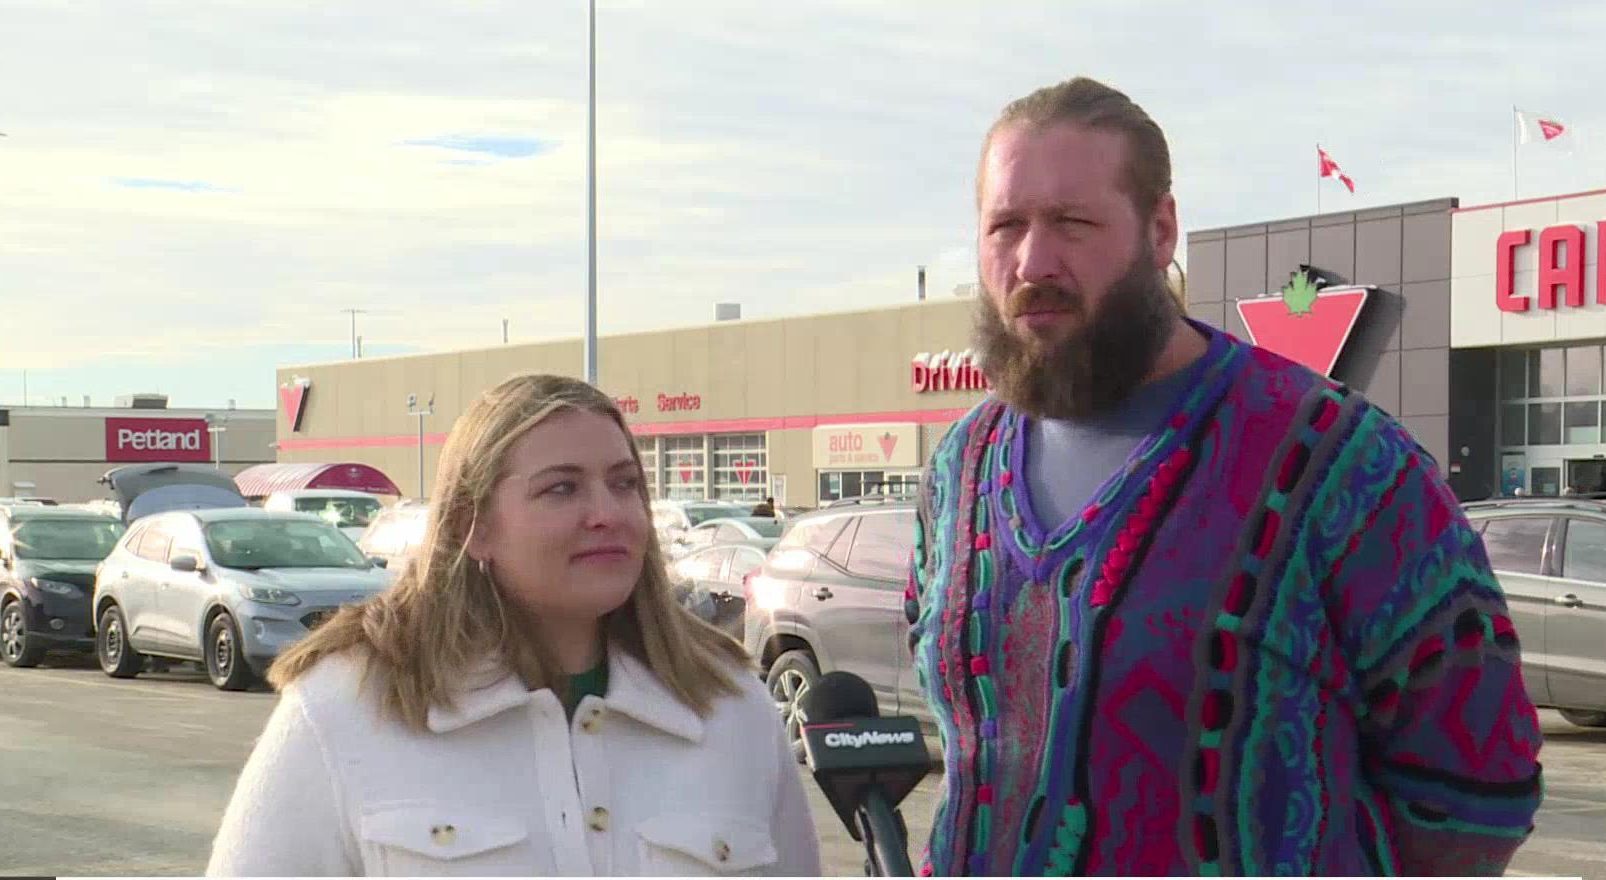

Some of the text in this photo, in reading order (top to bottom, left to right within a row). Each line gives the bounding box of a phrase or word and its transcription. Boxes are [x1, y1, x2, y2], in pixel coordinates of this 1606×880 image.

[1496, 220, 1606, 312] CA
[912, 355, 991, 392] Drivin
[657, 392, 701, 412] Service
[118, 428, 200, 450] Petland
[829, 431, 863, 452] auto
[825, 731, 914, 748] CityNews
